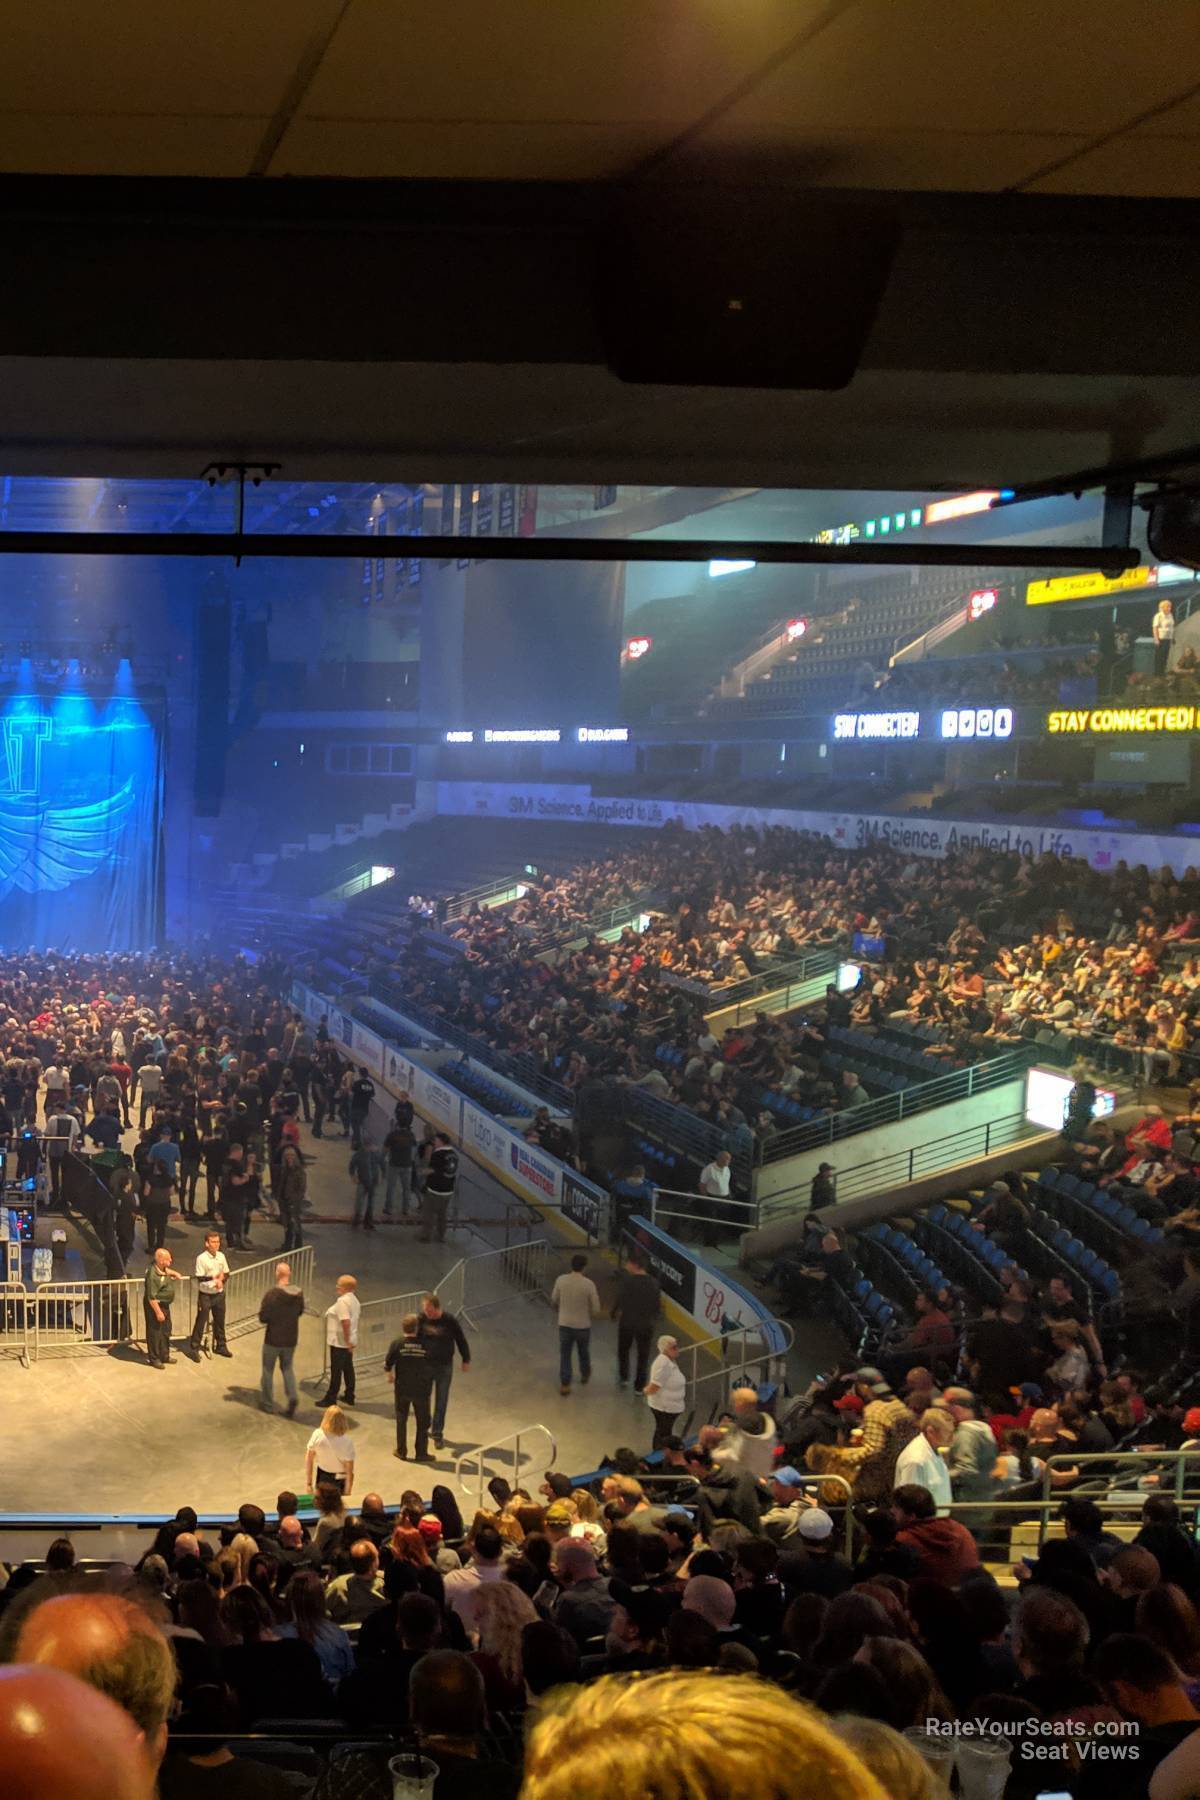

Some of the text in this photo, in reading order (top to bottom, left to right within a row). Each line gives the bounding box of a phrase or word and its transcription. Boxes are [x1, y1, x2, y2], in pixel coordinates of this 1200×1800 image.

[834, 711, 920, 738] STAY CONNECTED!
[1048, 707, 1195, 733] STAY CONNECTED!
[509, 796, 534, 813] 3M
[537, 797, 584, 817] Science.
[587, 800, 634, 821] Applied
[855, 818, 878, 843] 3M
[881, 821, 942, 850] Science.
